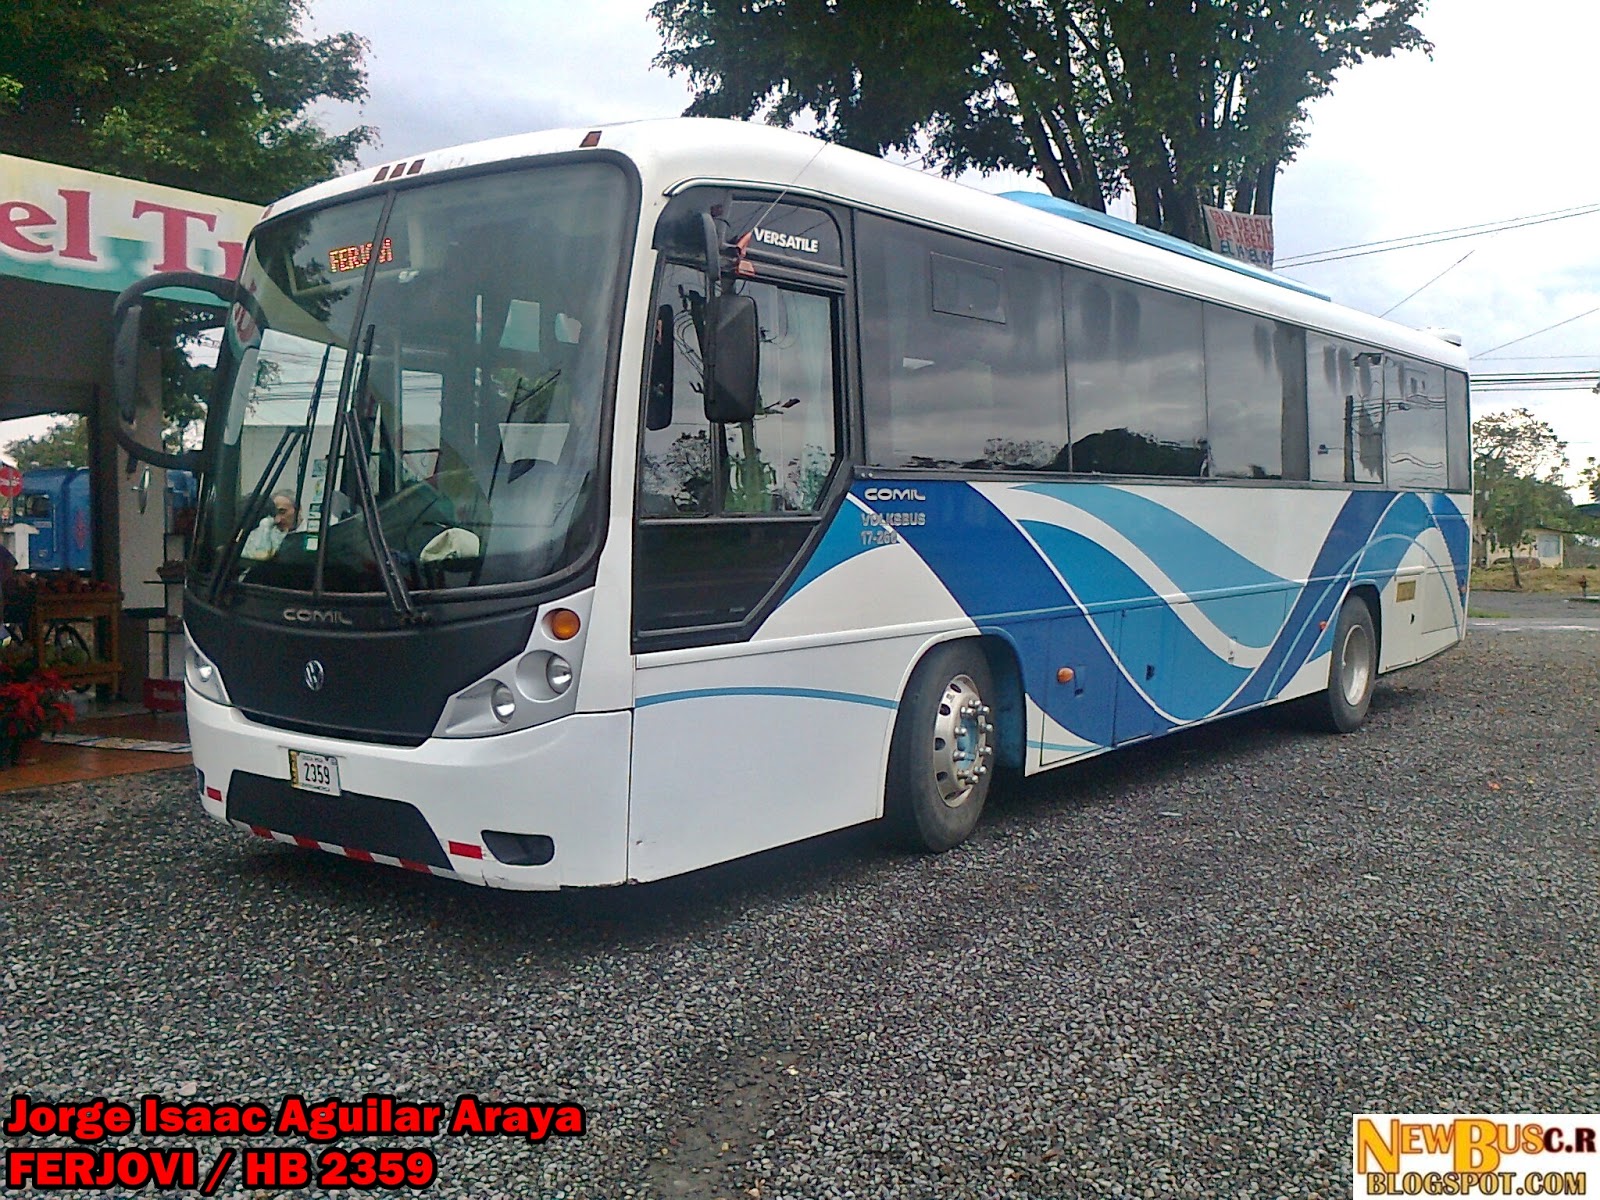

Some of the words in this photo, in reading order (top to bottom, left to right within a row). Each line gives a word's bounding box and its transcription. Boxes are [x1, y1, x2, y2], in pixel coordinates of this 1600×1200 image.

[753, 226, 819, 253] VERSATILE
[864, 487, 926, 501] COMIL
[860, 512, 926, 527] VOLKSBUS
[283, 607, 353, 625] COMIL
[304, 762, 331, 785] 2359
